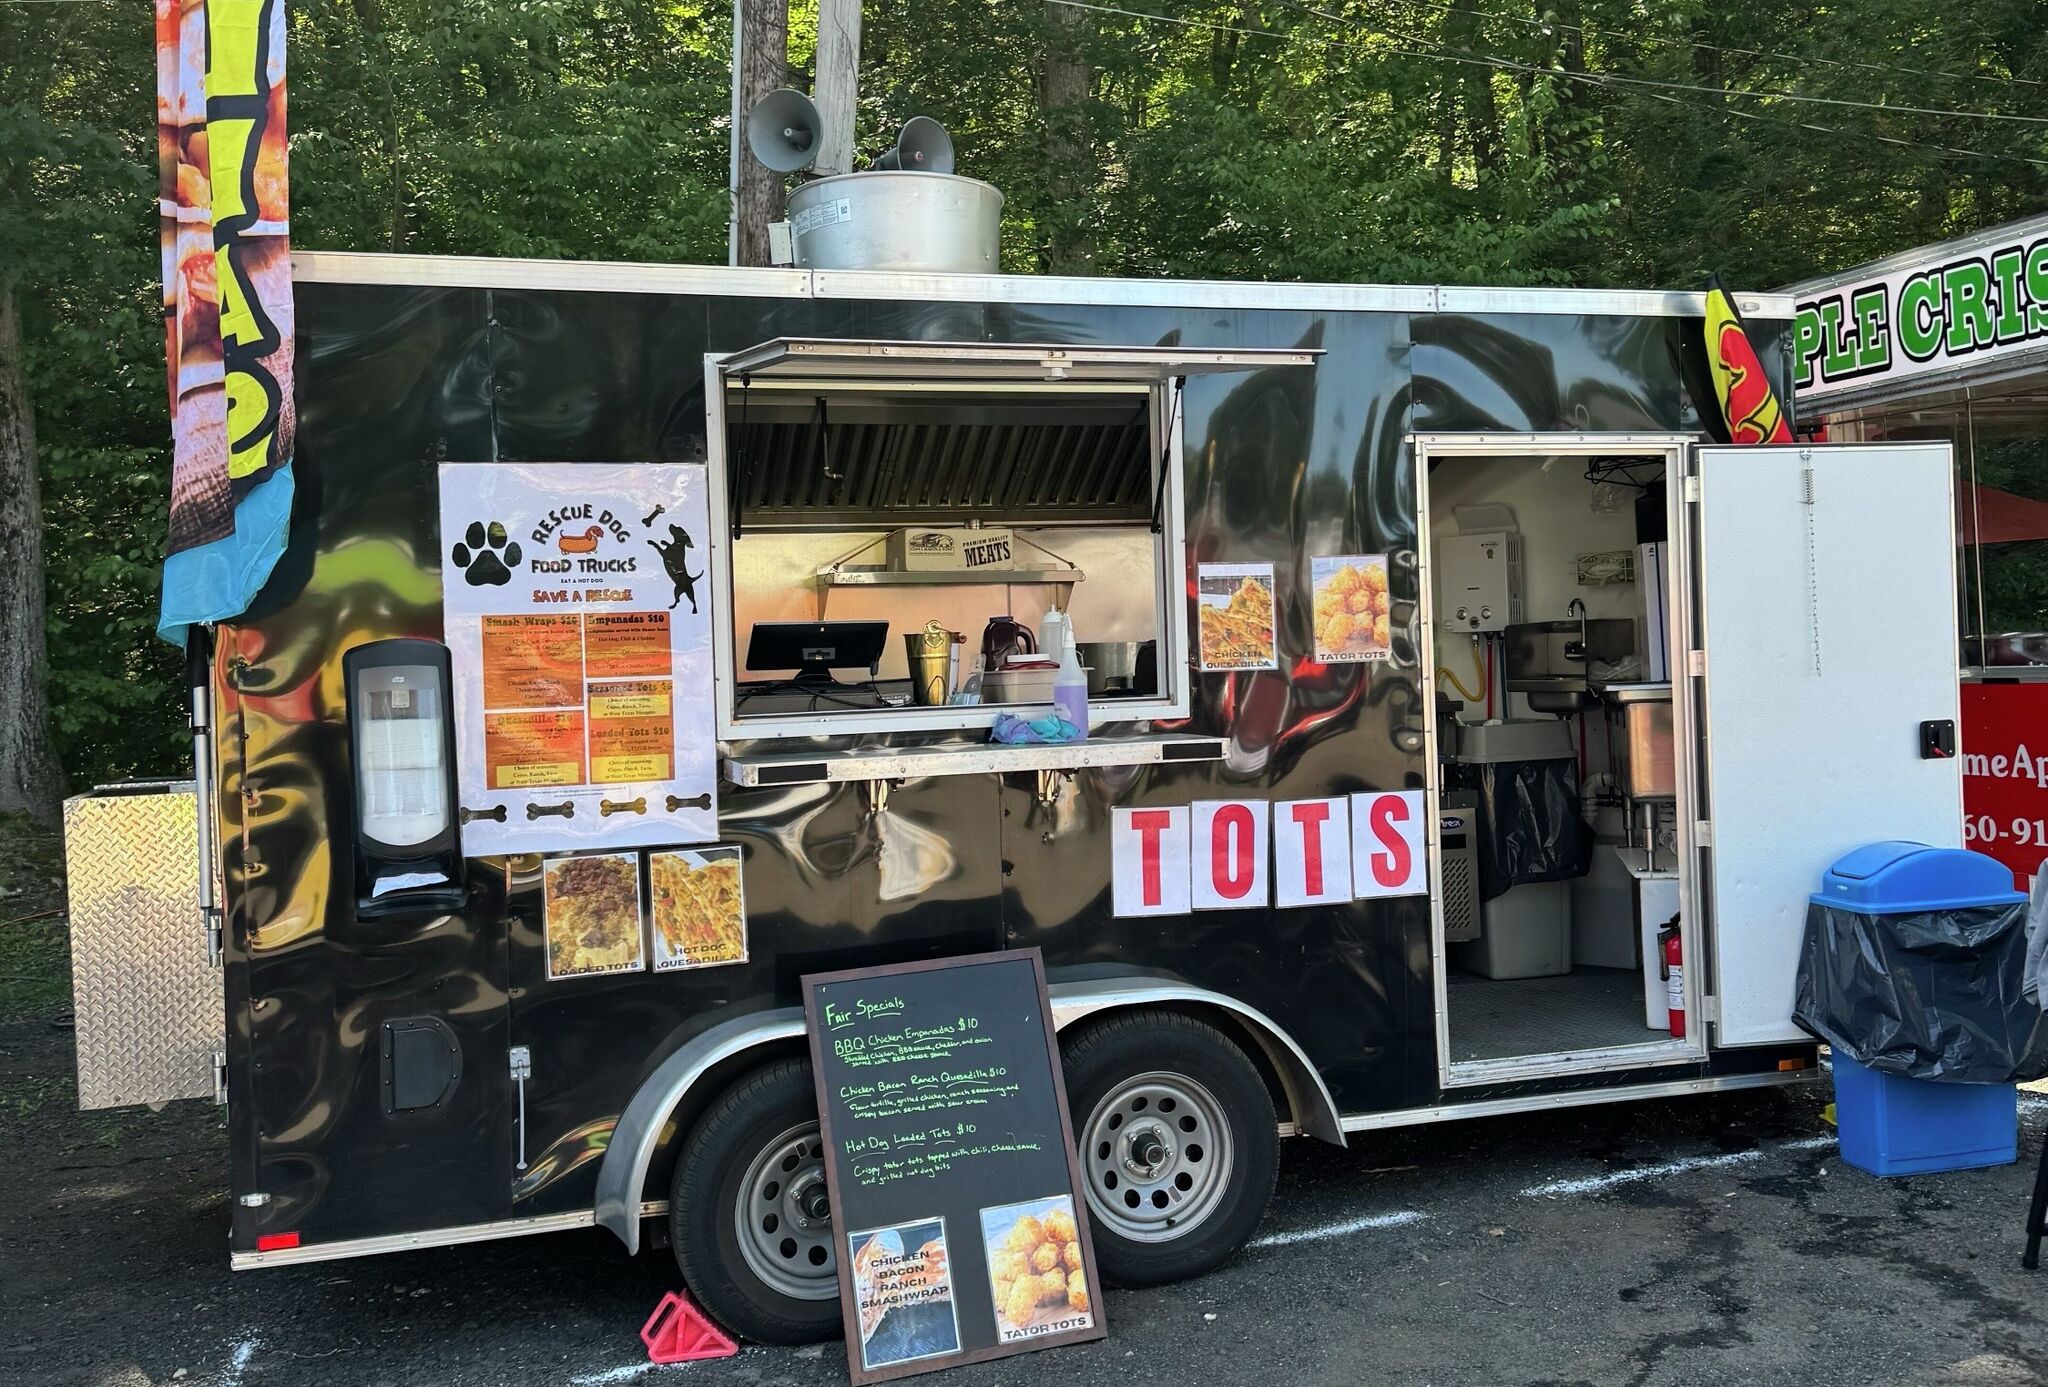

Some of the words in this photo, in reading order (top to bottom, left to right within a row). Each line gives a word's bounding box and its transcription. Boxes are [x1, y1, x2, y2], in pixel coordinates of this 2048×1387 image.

[532, 503, 592, 545] RESCUE
[599, 510, 630, 543] DOG
[963, 538, 986, 547] PREMIUM
[988, 535, 1009, 543] QUALITY
[964, 541, 1011, 568] MEATS
[531, 559, 572, 573] FOOD
[578, 557, 636, 573] TRUCKS
[533, 590, 568, 603] SAVE
[572, 590, 583, 602] A
[585, 588, 632, 602] RESCUE
[486, 617, 520, 626] Smash
[524, 616, 556, 627] Wraps
[588, 615, 644, 625] Empanadas
[648, 614, 664, 623] $10
[1214, 651, 1262, 659] CHICKEN
[1319, 653, 1356, 661] TATOR
[1357, 651, 1386, 660] TOTS
[1206, 660, 1271, 669] QUESADILLA
[636, 682, 657, 691] Tots
[629, 727, 650, 736] Tots
[653, 726, 669, 735] $10
[1131, 795, 1411, 906] TOTS
[677, 946, 699, 956] HOT
[700, 943, 726, 953] DOG
[660, 953, 738, 968] QUESADILLA
[552, 964, 604, 976] LOADED
[606, 962, 638, 972] TOTS
[826, 1003, 852, 1026] Fair
[856, 997, 905, 1020] Specials
[834, 1037, 866, 1056] BBQ
[868, 1034, 904, 1046] Chicken
[904, 1026, 955, 1039] Empanadas
[958, 1017, 978, 1031] $10
[840, 1086, 875, 1098] Chicken
[877, 1081, 907, 1091] Bacon
[911, 1074, 939, 1086] Ranch
[940, 1071, 987, 1083] Quesadilla
[988, 1067, 1007, 1077] $10
[896, 1095, 919, 1106] grilled
[878, 1109, 902, 1117] bacon
[903, 1104, 926, 1113] served
[928, 1101, 945, 1109] with
[846, 1140, 866, 1153] Hot
[869, 1136, 889, 1150] Dog
[893, 1131, 927, 1143] Loaded
[929, 1128, 951, 1139] Tots
[956, 1122, 976, 1136] $10
[853, 1165, 880, 1177] Crispy
[907, 1156, 924, 1165] tots
[927, 1151, 950, 1163] topped
[951, 1148, 970, 1157] with
[861, 1177, 876, 1185] and
[879, 1171, 903, 1185] grilled
[920, 1168, 936, 1178] dog
[934, 1163, 951, 1171] bits
[871, 1251, 930, 1268] CHICKEN
[879, 1264, 925, 1279] BACON
[880, 1277, 927, 1293] RANCH
[861, 1286, 949, 1310] SMASHWRAP
[1004, 1324, 1049, 1341] TATOR
[1052, 1317, 1087, 1331] TOTS
